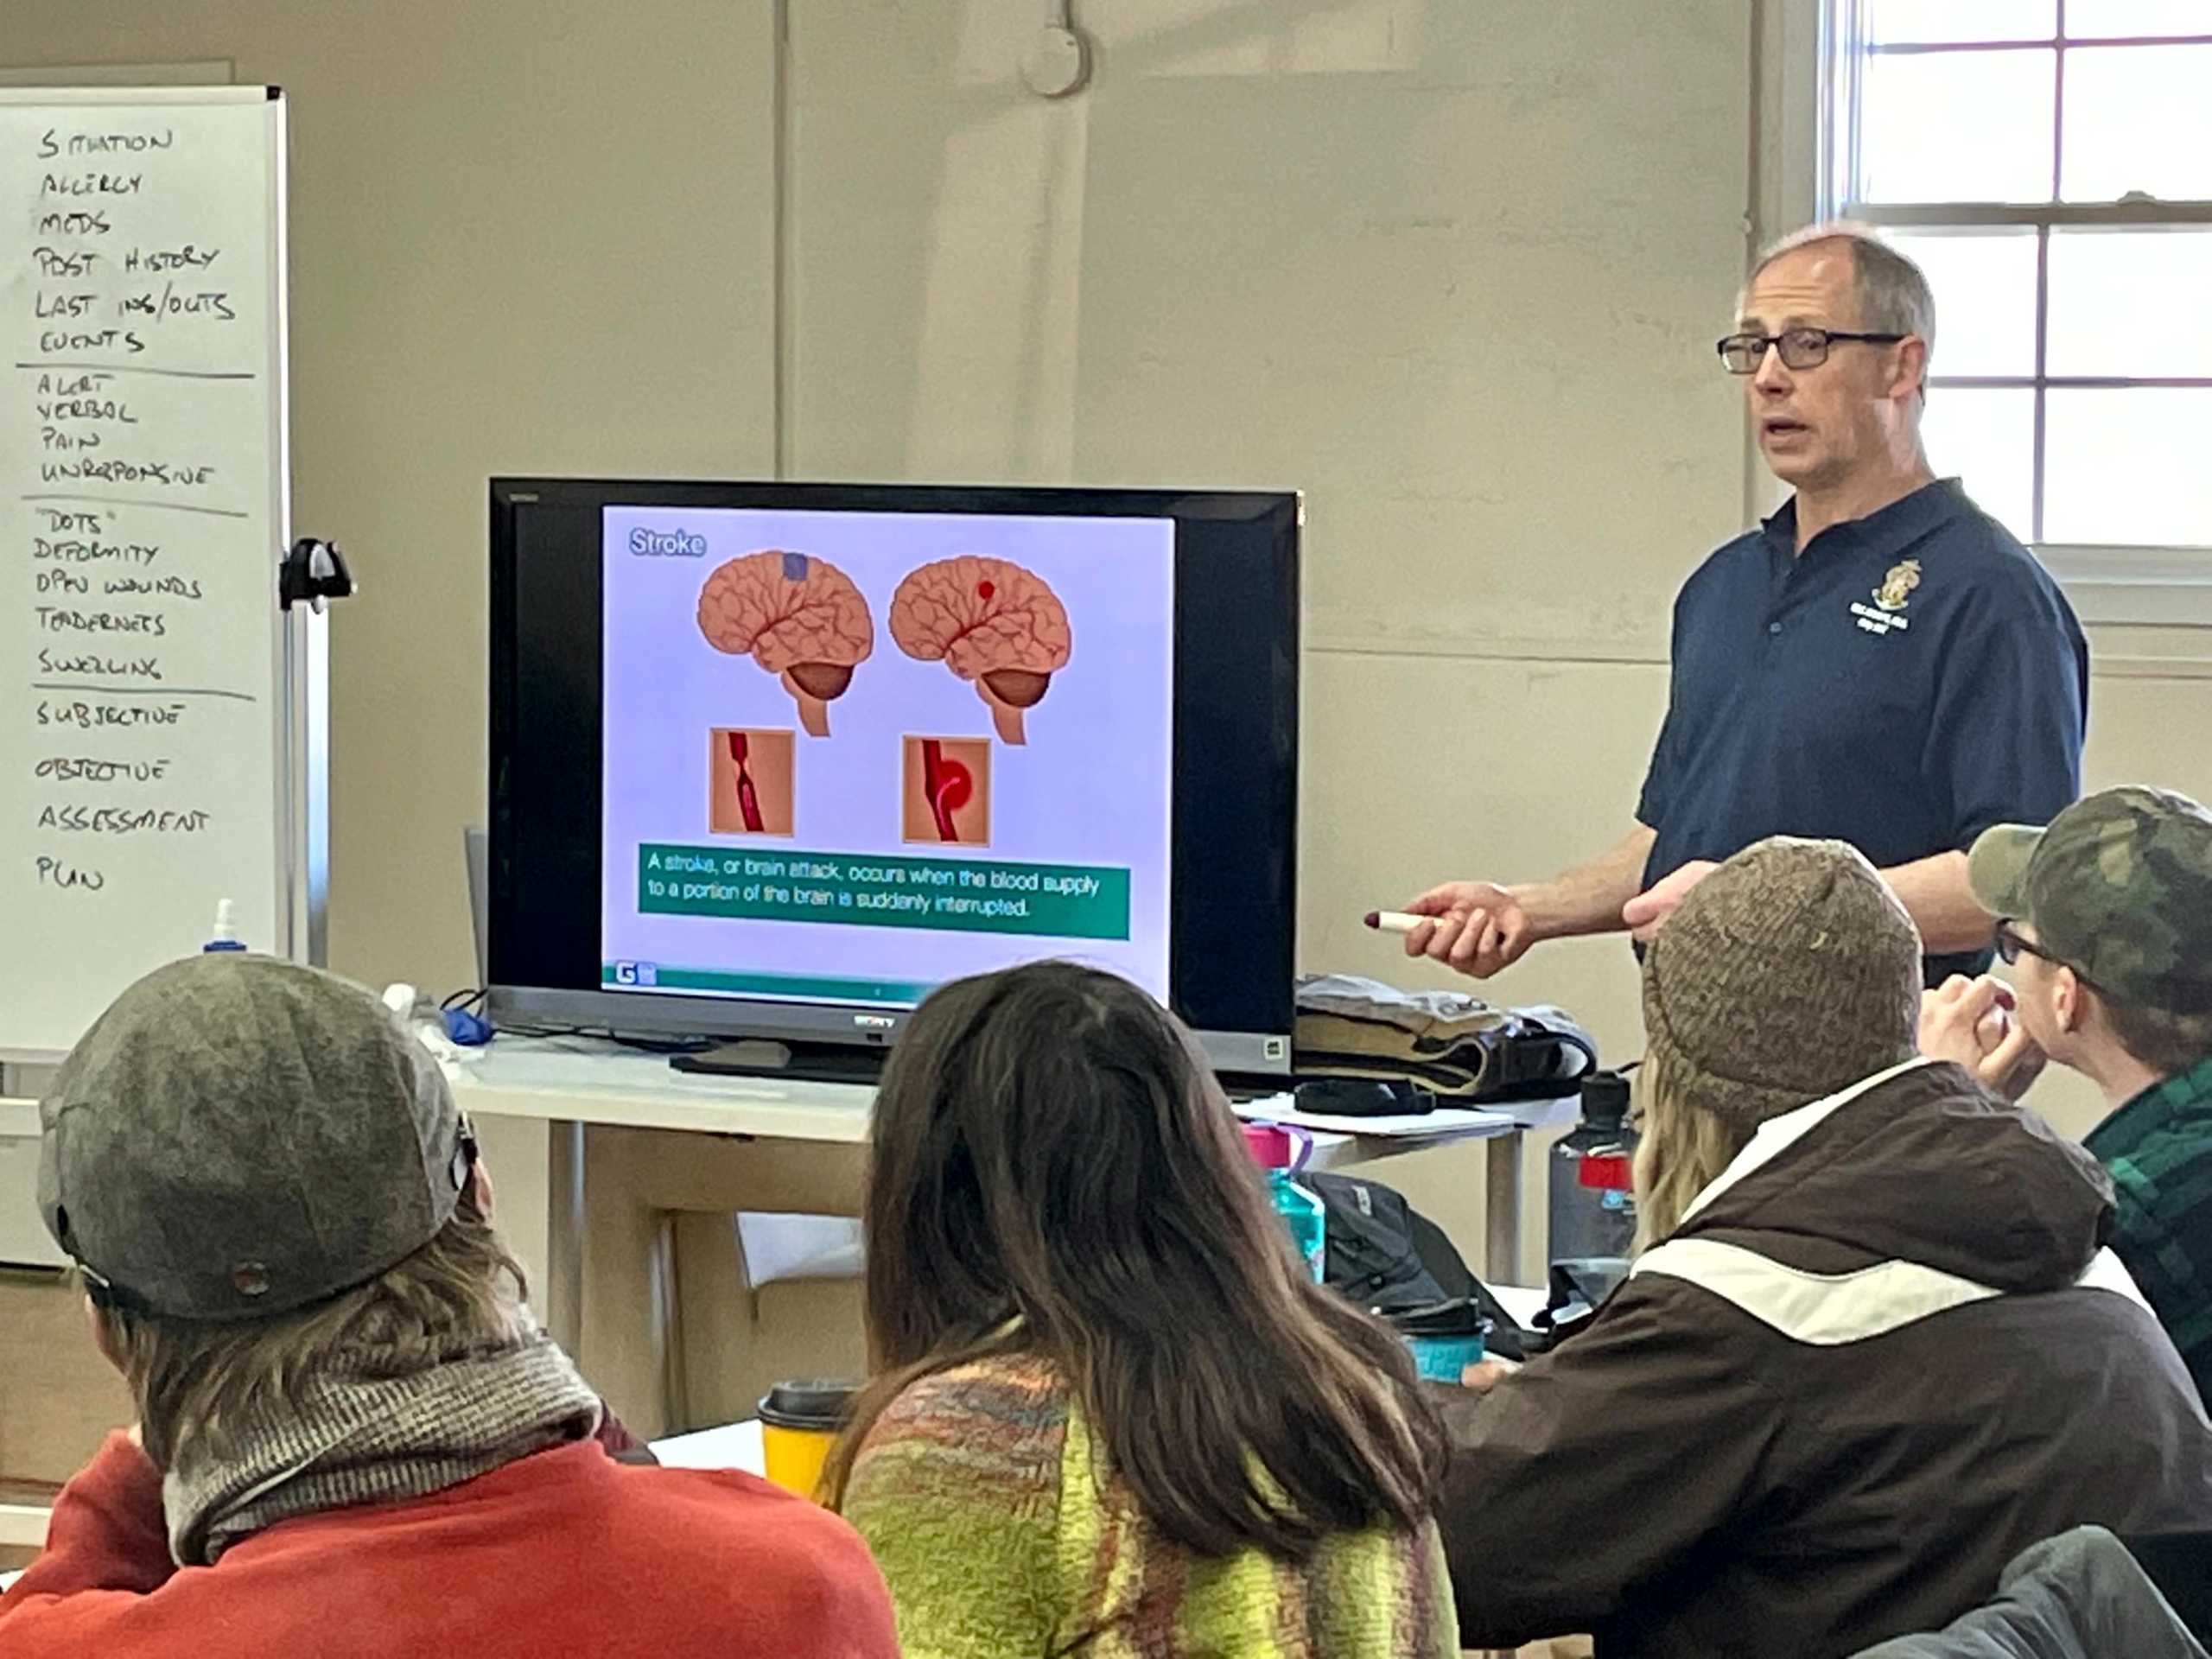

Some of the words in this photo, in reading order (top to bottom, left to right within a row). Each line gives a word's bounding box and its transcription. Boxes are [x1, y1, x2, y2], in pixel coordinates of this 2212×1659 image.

[125, 245, 220, 272] HISTORY
[35, 290, 97, 318] LAST
[41, 426, 100, 450] PAIN
[629, 527, 707, 557] Stroke
[37, 805, 211, 834] ASSESSMENT
[648, 851, 662, 870] A
[664, 853, 720, 875] stroke,
[723, 858, 741, 874] or
[744, 858, 785, 877] brain
[788, 860, 844, 881] attack,
[849, 866, 906, 884] occurs
[909, 866, 955, 887] when
[958, 870, 987, 888] the
[990, 870, 1039, 891] blood
[1043, 874, 1100, 899] supply
[648, 879, 664, 897] to
[668, 884, 679, 898] a
[683, 882, 740, 900] portion
[742, 883, 761, 901] of
[763, 886, 790, 904] the
[793, 887, 834, 906] brain
[838, 889, 852, 906] is
[856, 891, 931, 916] suddenly
[935, 894, 1030, 918] interrupted.
